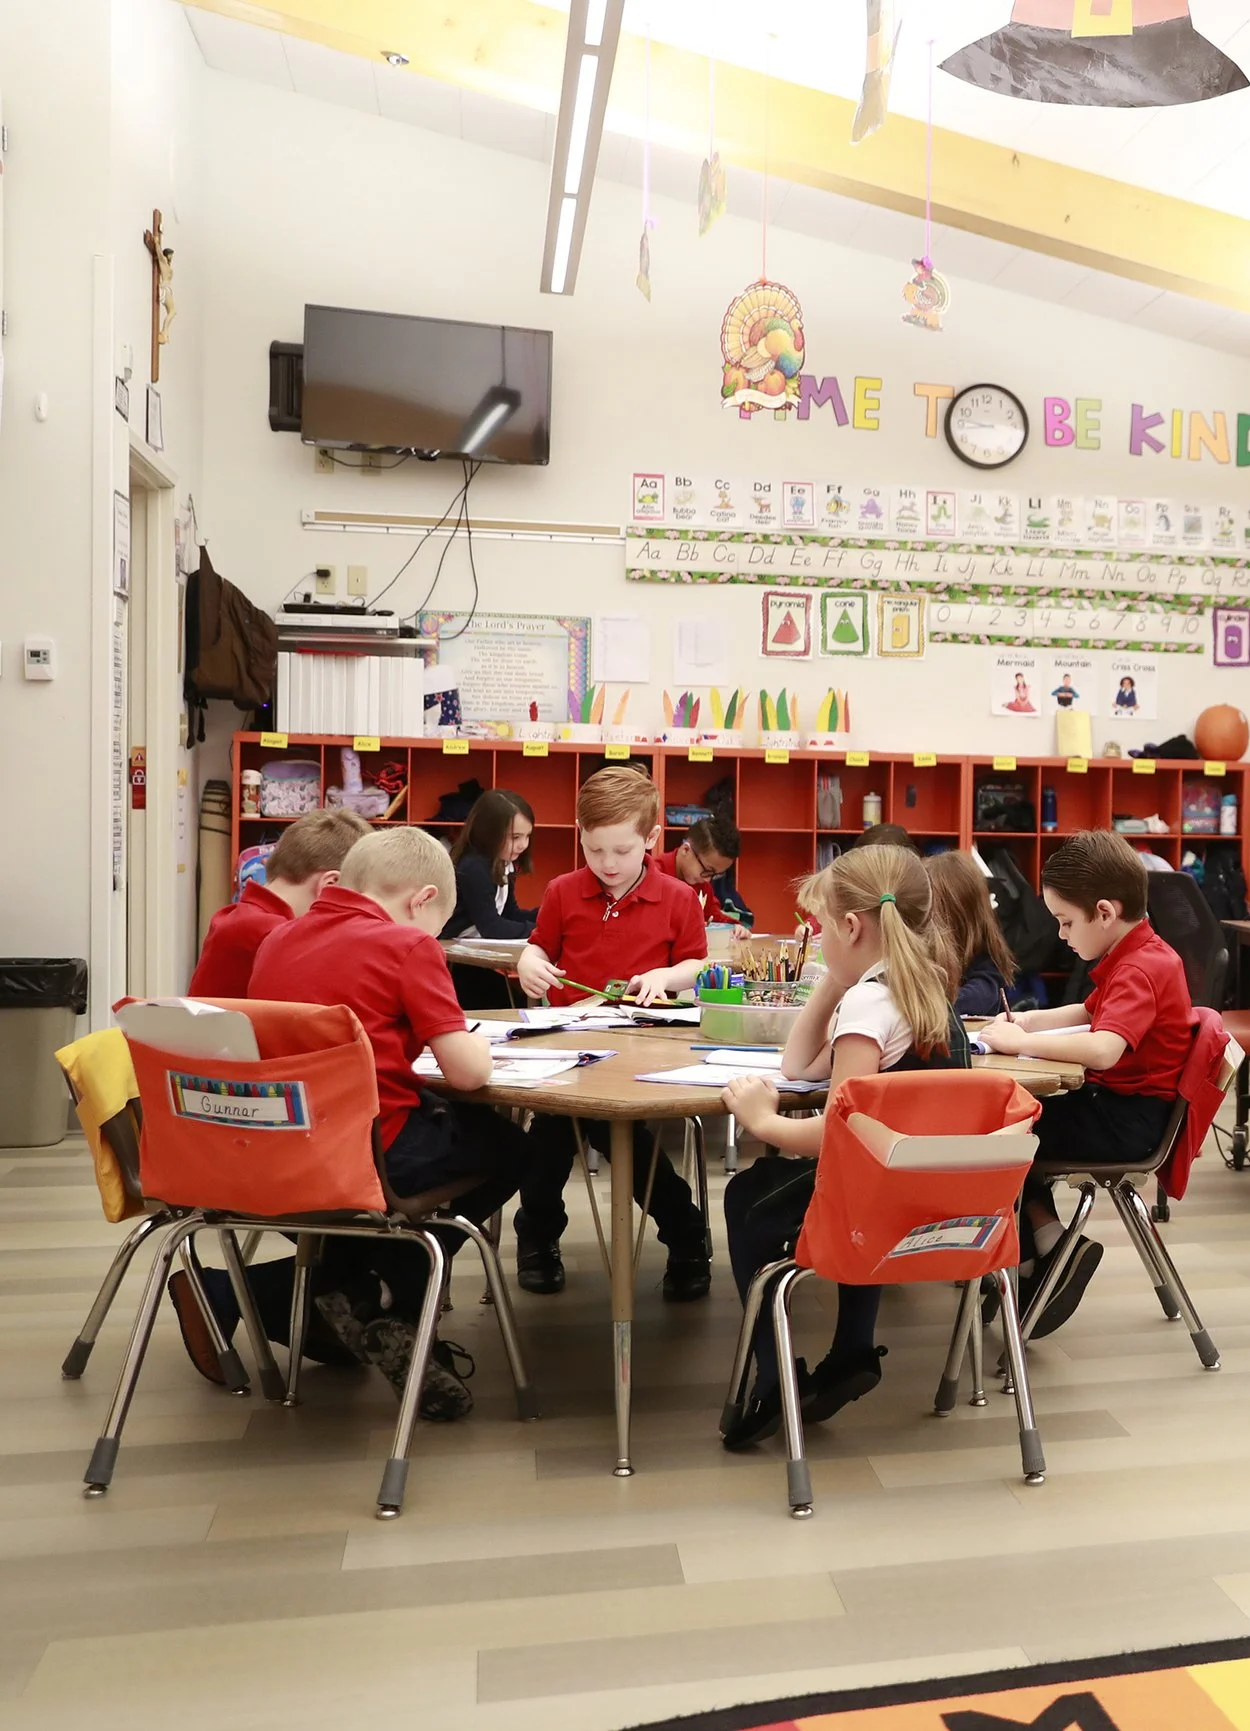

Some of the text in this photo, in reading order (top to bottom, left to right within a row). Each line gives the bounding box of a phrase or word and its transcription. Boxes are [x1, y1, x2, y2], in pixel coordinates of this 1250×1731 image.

[982, 394, 992, 404] 12
[738, 375, 882, 430] ME
[1043, 397, 1102, 450] BE
[640, 478, 658, 490] Aa
[675, 477, 692, 487] Bb
[714, 479, 730, 490] Cc
[753, 482, 771, 493] Dd
[790, 485, 805, 495] Ee
[826, 484, 842, 495] Ff
[899, 489, 916, 499] Hh
[1028, 497, 1041, 509] Ll
[636, 541, 662, 561] Aa
[676, 542, 699, 562] Bb
[713, 544, 736, 563] Cc
[748, 546, 774, 565] Dd
[790, 547, 812, 566] Ee
[822, 549, 848, 568] Ff
[860, 551, 882, 577] Gg
[895, 552, 920, 573] Hh
[934, 554, 948, 573] Ii
[958, 555, 976, 582] Jj
[989, 557, 1014, 576] Kk
[1026, 558, 1045, 577] Ll
[1059, 561, 1090, 580] Mm
[1101, 563, 1126, 582] Nn
[1136, 565, 1156, 583] Oo
[1167, 566, 1187, 591] Pp
[1201, 567, 1222, 594] Qq
[770, 600, 805, 610] pyramid
[834, 600, 856, 608] cone
[937, 605, 1200, 635] 0 1 2 3 4 5 6 7 8 9 10
[485, 620, 514, 630] Lord's
[517, 622, 546, 632] Prayer
[997, 658, 1035, 668] Mermaid
[1054, 659, 1092, 669] Mountain
[1111, 662, 1156, 673] Criss Cross
[200, 1095, 259, 1118] Gunnar
[903, 1234, 944, 1247] Alice
[940, 1691, 1121, 1731] M
